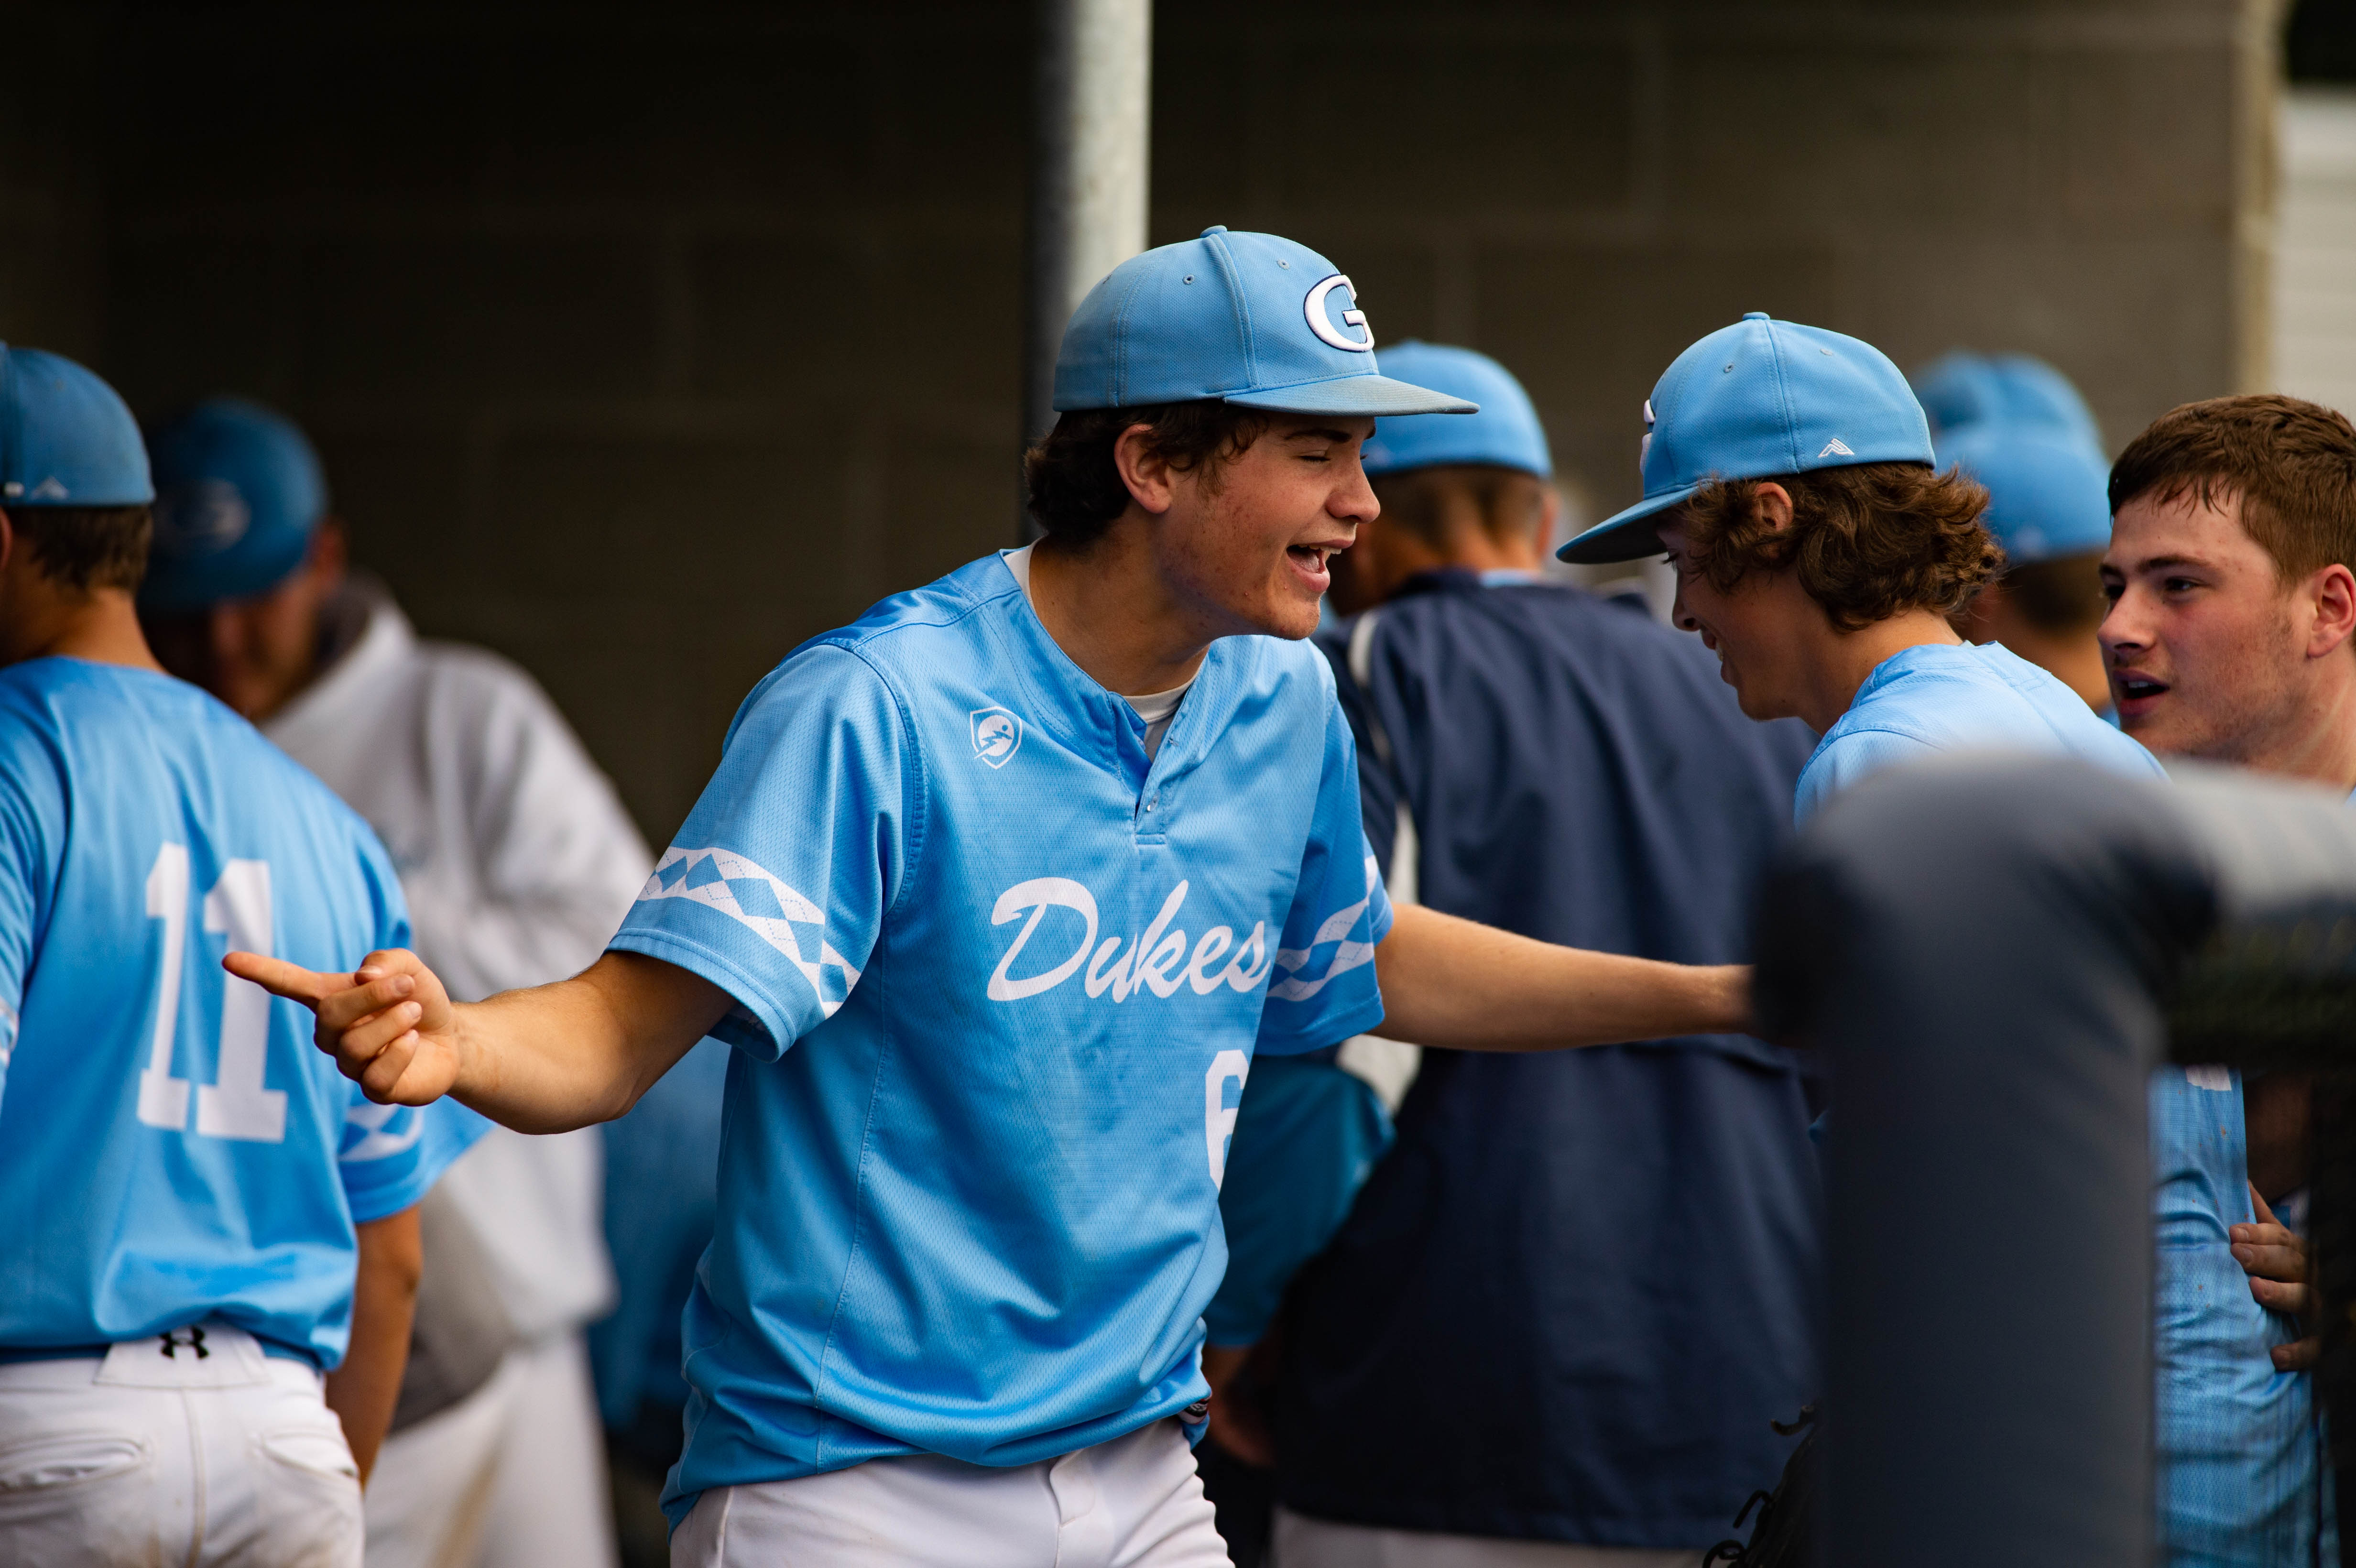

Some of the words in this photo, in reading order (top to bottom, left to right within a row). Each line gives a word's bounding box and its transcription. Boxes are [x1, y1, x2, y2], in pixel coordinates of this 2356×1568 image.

[1303, 273, 1374, 353] G
[137, 840, 287, 1143] 11
[987, 876, 1271, 1003] Dukes
